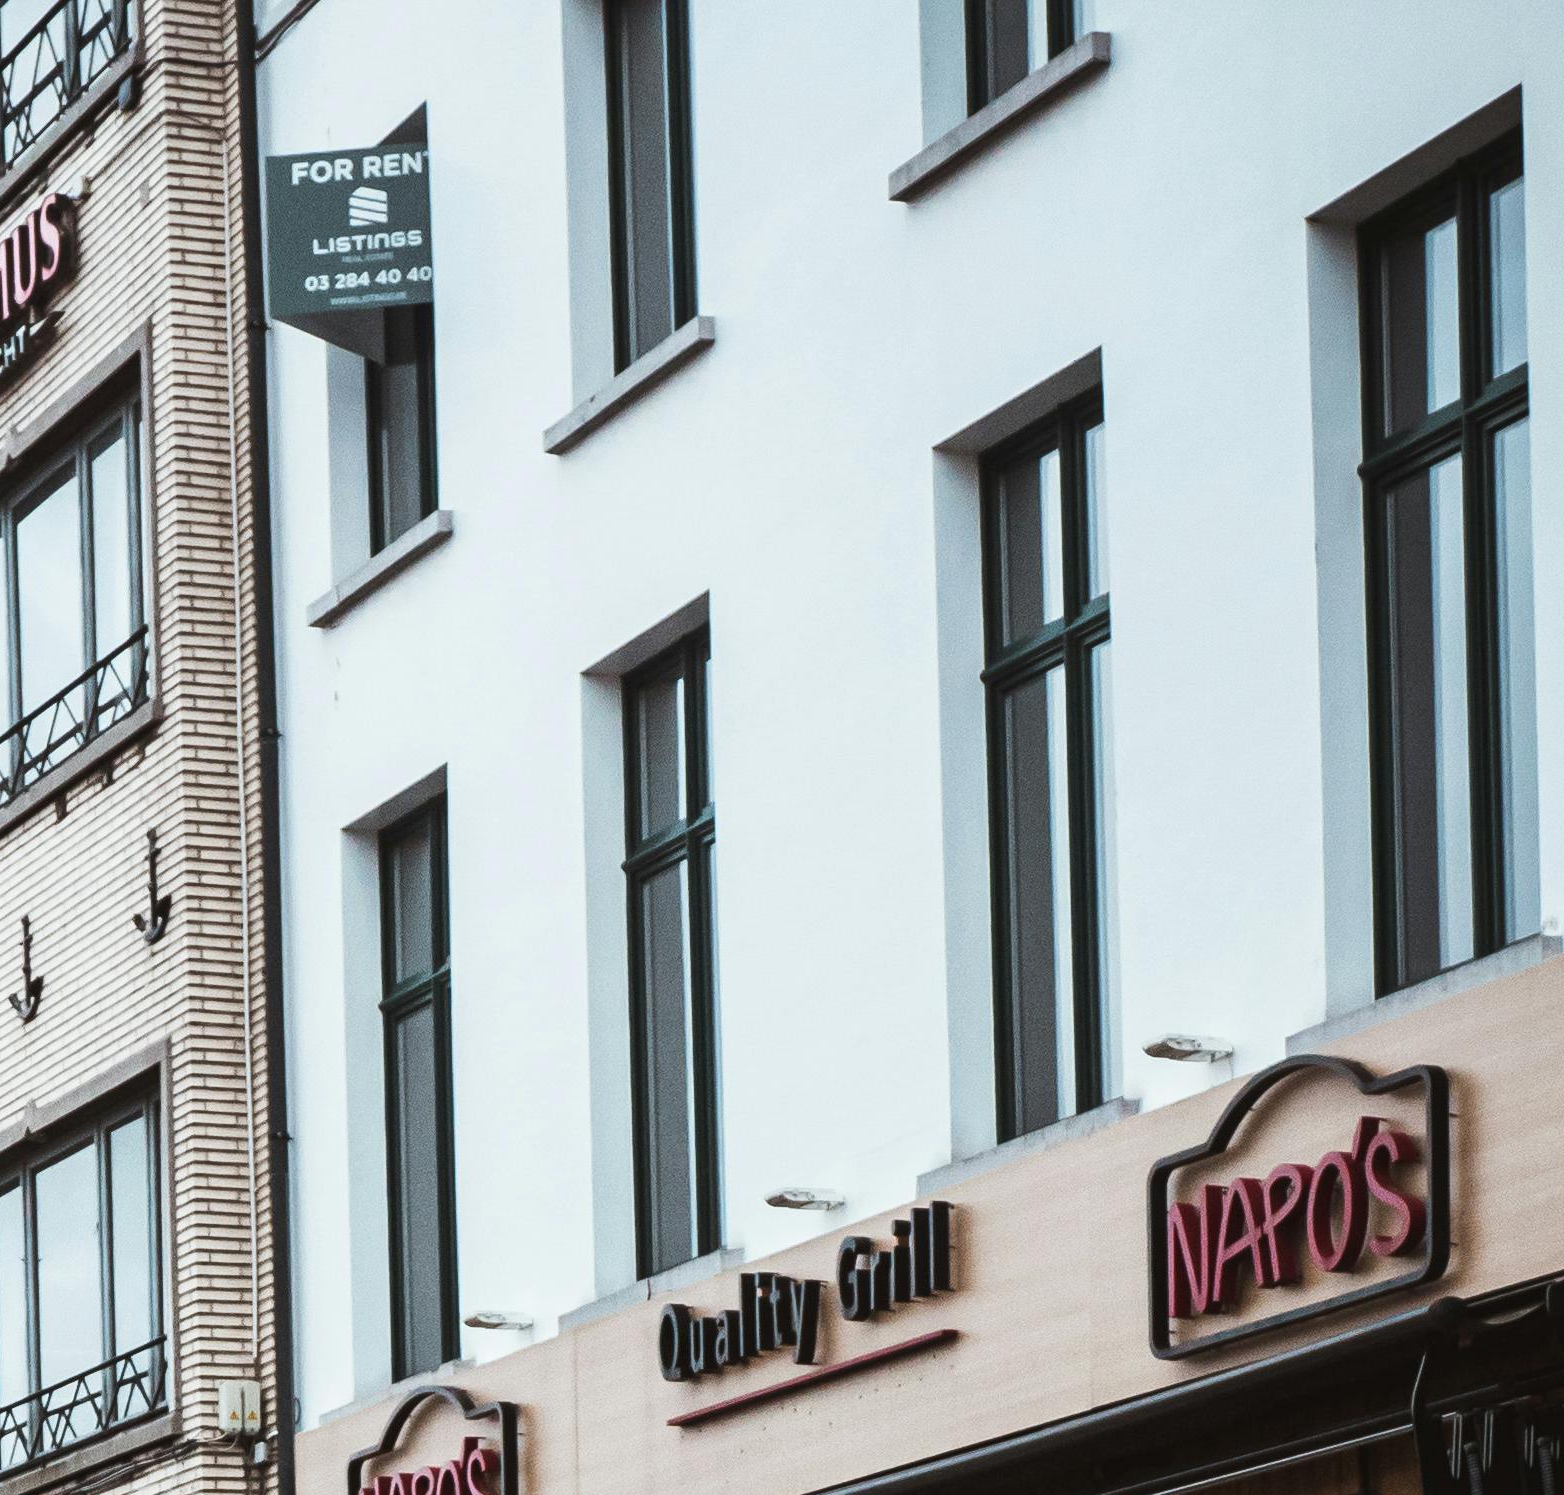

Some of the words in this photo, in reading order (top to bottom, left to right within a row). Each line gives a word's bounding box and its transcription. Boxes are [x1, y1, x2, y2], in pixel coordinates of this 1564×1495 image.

[291, 158, 354, 185] FOR
[362, 151, 429, 179] REN
[312, 230, 423, 255] LISTINGS
[304, 275, 330, 291] 03
[334, 271, 370, 289] 284
[375, 268, 402, 284] 40
[406, 266, 432, 281] 40
[1167, 1115, 1424, 1318] NAPO'S
[658, 1271, 823, 1382] Quality
[836, 1200, 953, 1322] Grill
